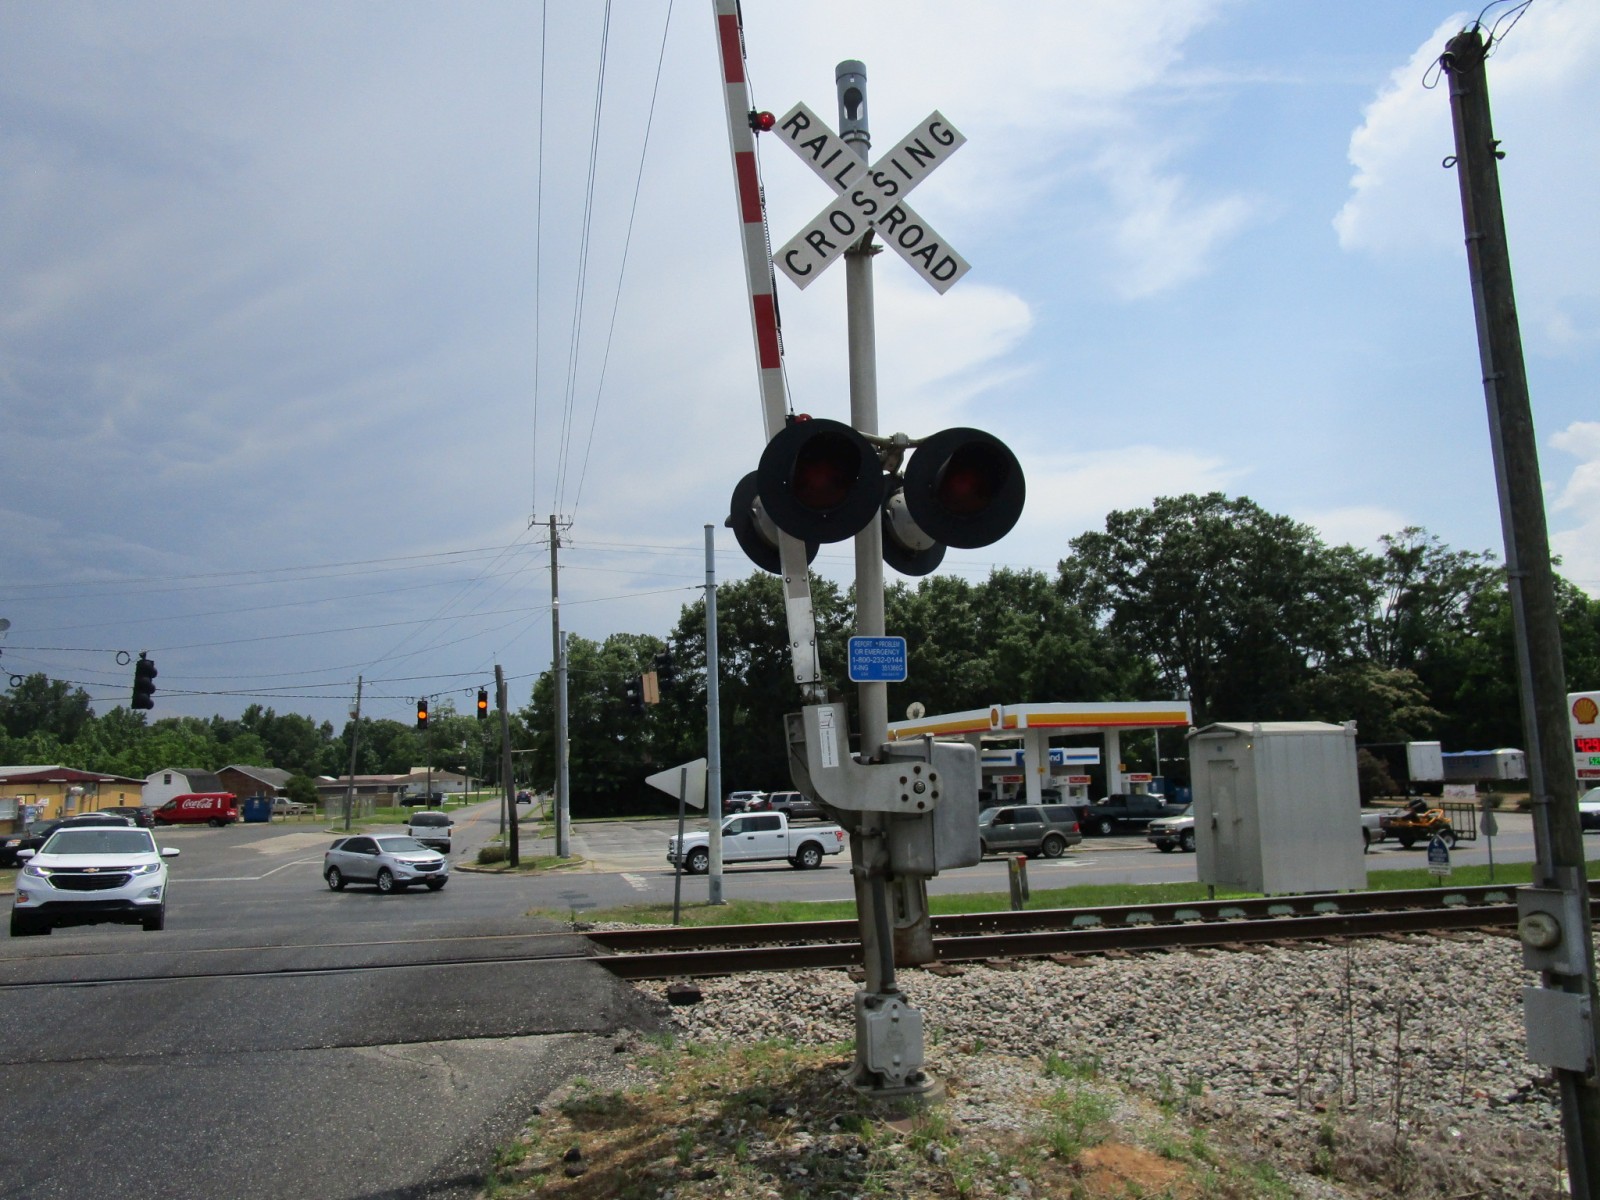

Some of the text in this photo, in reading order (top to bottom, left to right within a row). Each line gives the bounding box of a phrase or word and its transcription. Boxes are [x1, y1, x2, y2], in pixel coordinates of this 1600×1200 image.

[781, 110, 958, 282] RAIL ROAD
[785, 121, 955, 276] CROSSING
[854, 640, 901, 648] REPORT PROBLEM
[854, 648, 900, 656] OR EMERGENCY
[852, 656, 903, 664] 1-800-232-0144
